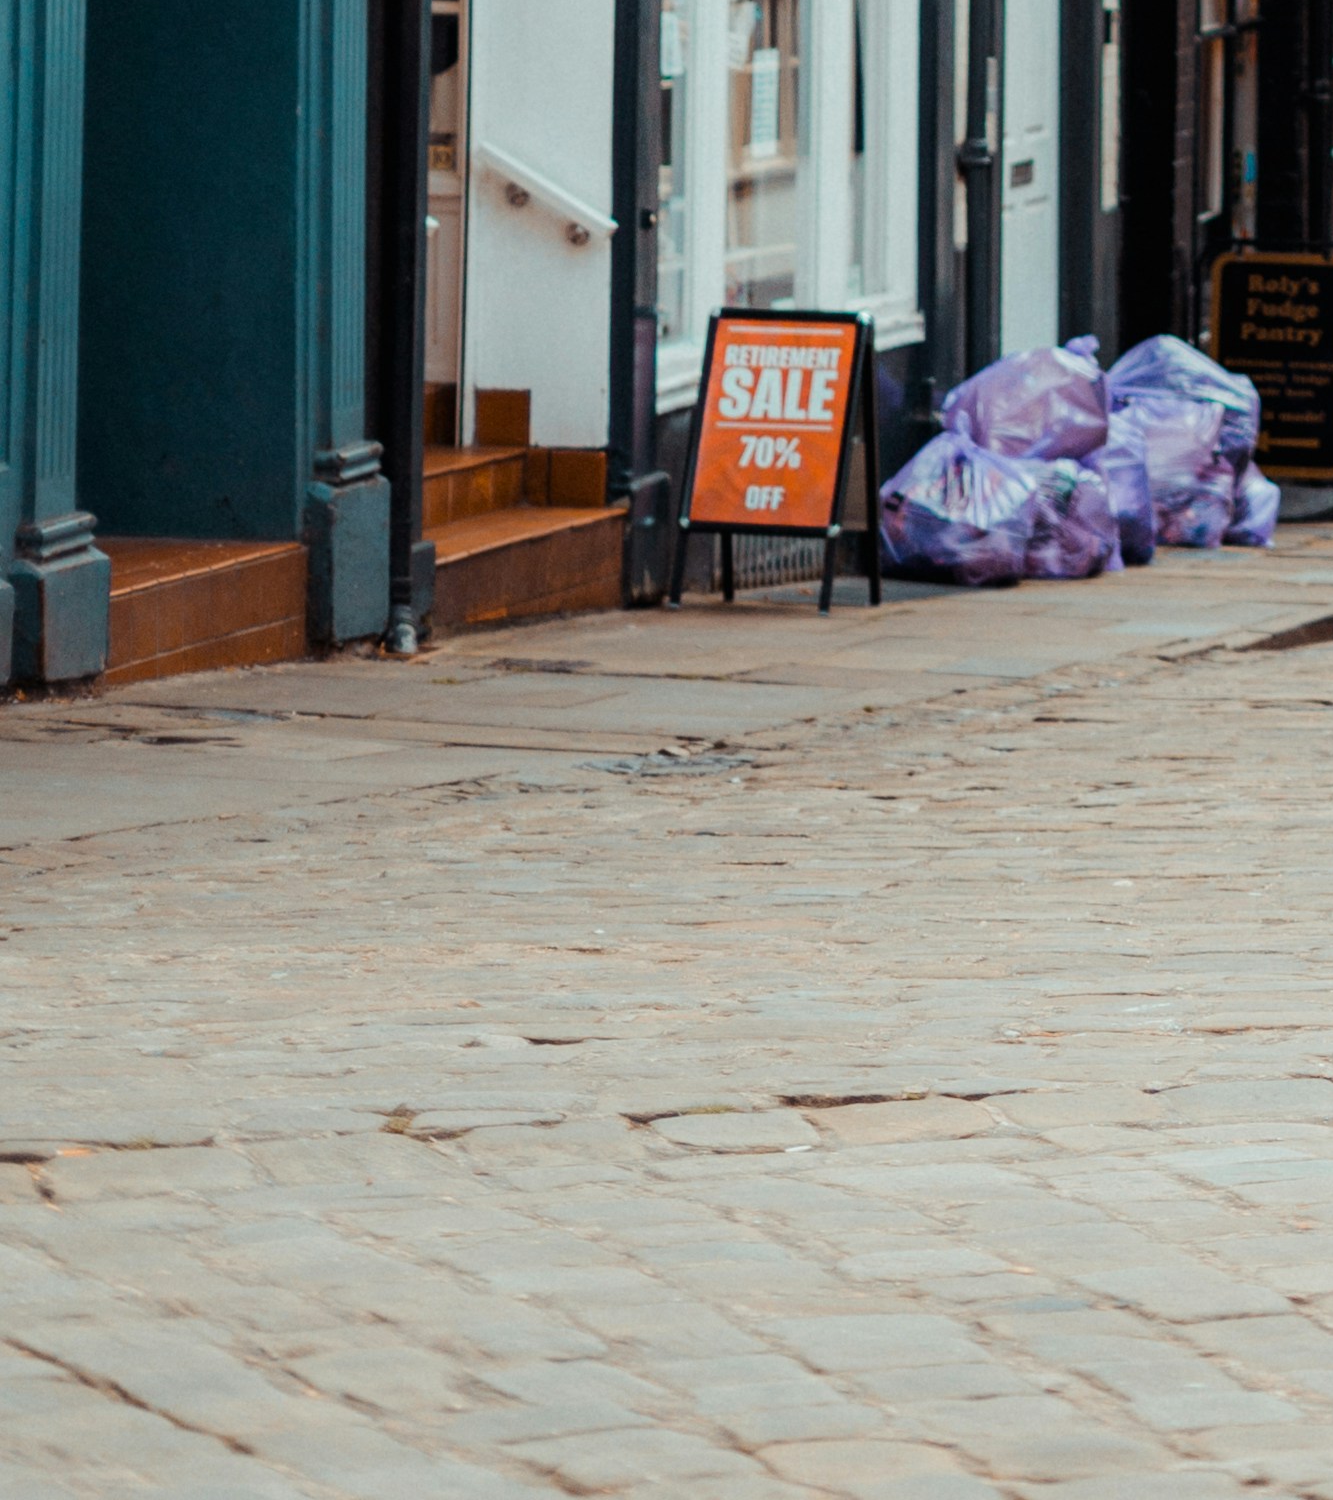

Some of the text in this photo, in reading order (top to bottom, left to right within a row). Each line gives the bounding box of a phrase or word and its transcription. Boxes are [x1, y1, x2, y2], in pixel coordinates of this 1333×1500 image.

[1247, 273, 1320, 297] Roly's
[1246, 297, 1320, 322] Fudge
[1240, 321, 1323, 348] Pantry
[724, 343, 842, 369] RETIREMENT
[718, 366, 839, 421] SALE
[738, 435, 802, 469] 70%
[744, 484, 786, 511] OFF
